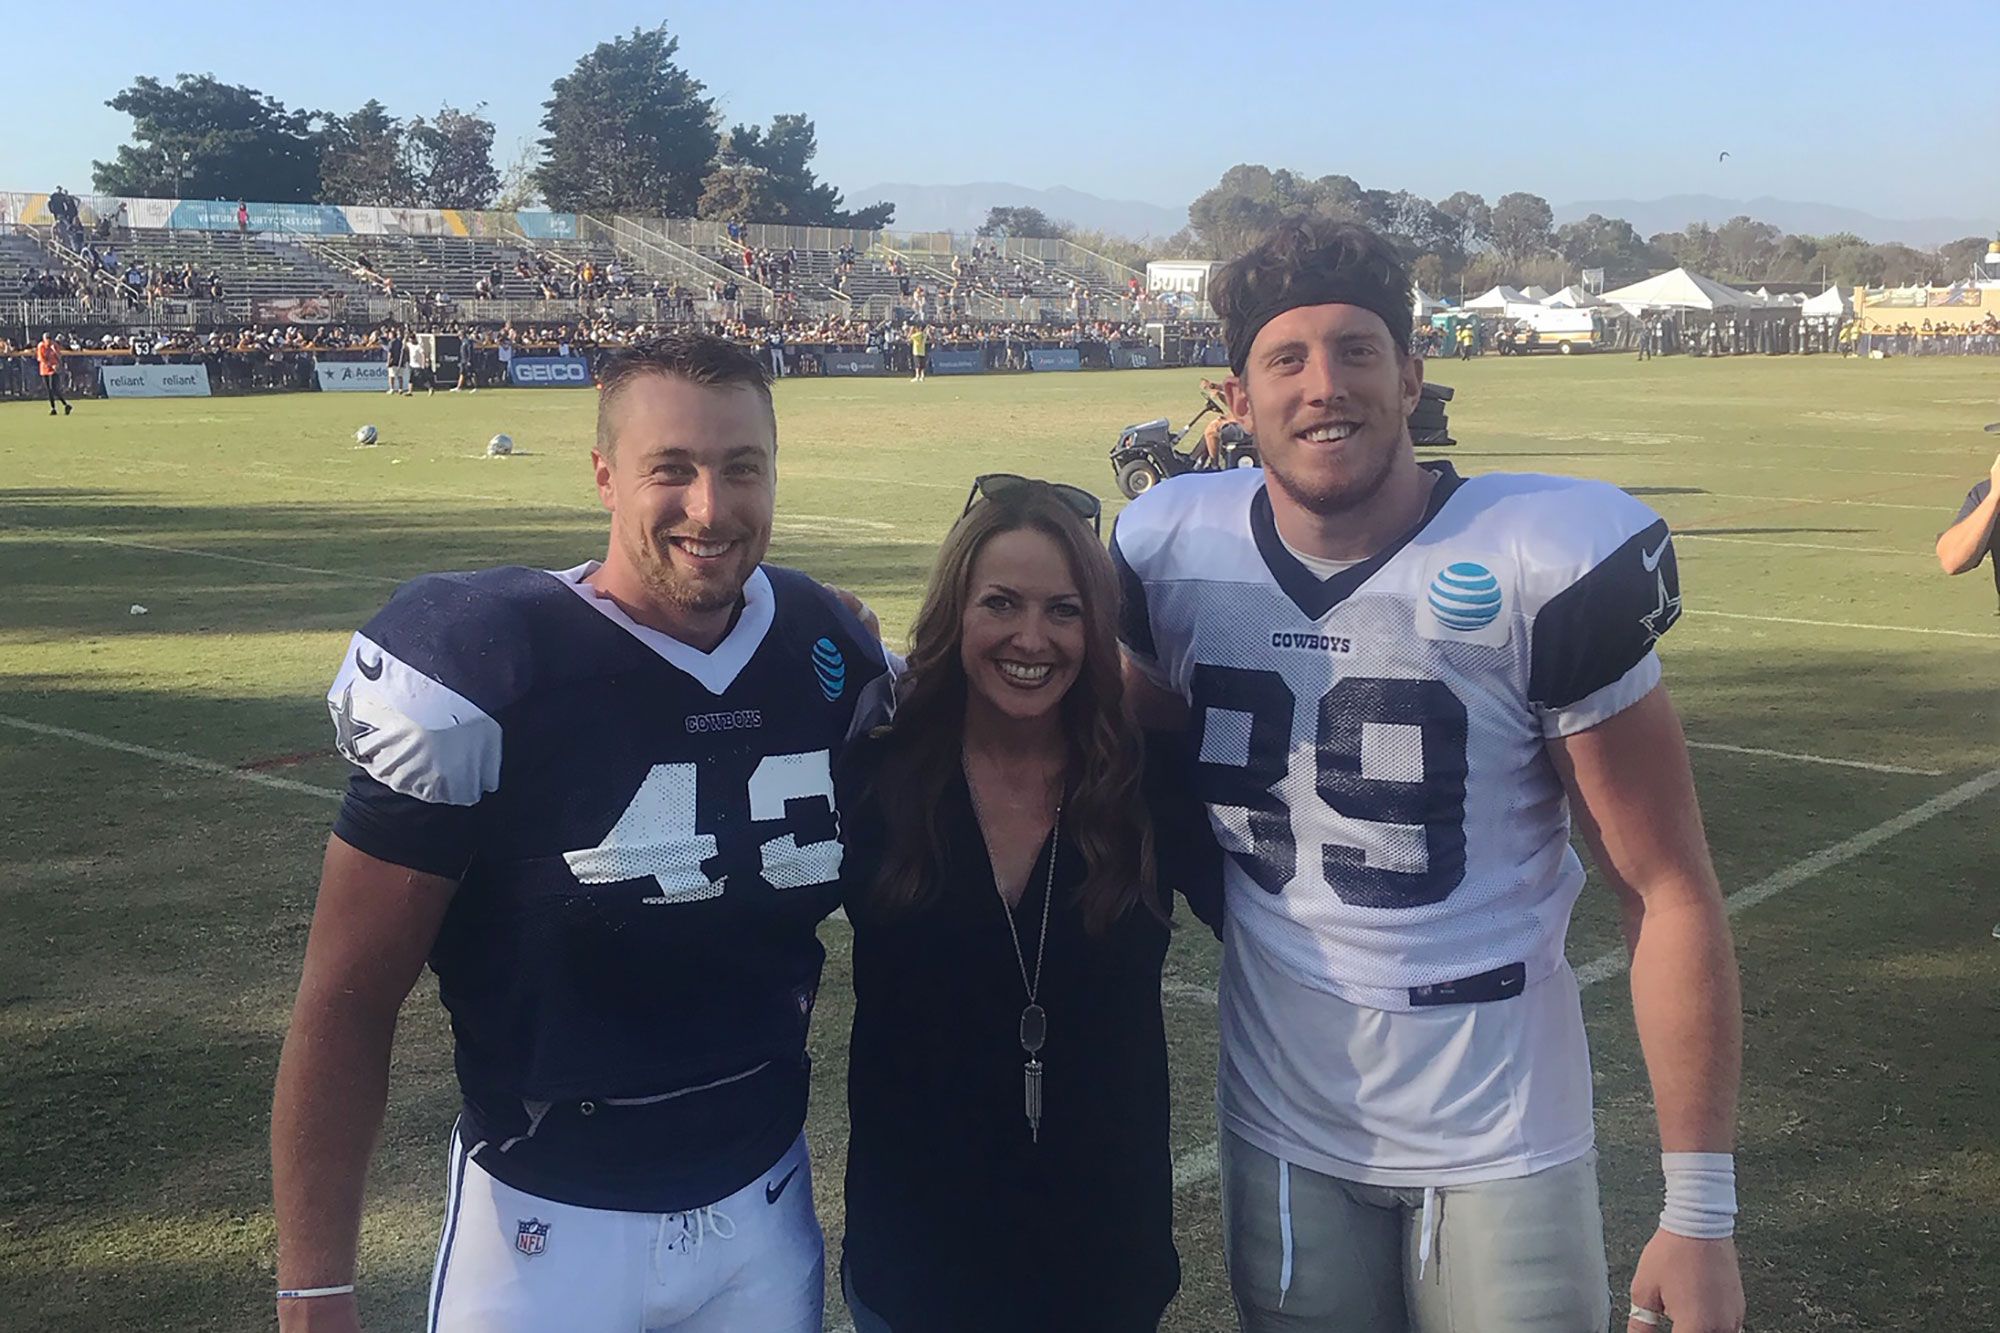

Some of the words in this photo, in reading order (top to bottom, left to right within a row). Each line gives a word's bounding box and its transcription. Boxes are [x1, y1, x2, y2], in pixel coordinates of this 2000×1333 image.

[198, 214, 321, 225] VENTURAUNTYCOAST.COM
[110, 376, 145, 387] reliant
[163, 375, 197, 386] reliant
[515, 364, 584, 381] GEICO
[1272, 632, 1351, 653] COWBOYS
[685, 710, 762, 733] COWBOYS
[1190, 663, 1469, 909] 89
[562, 748, 845, 905] 43
[519, 1234, 543, 1252] NFL
